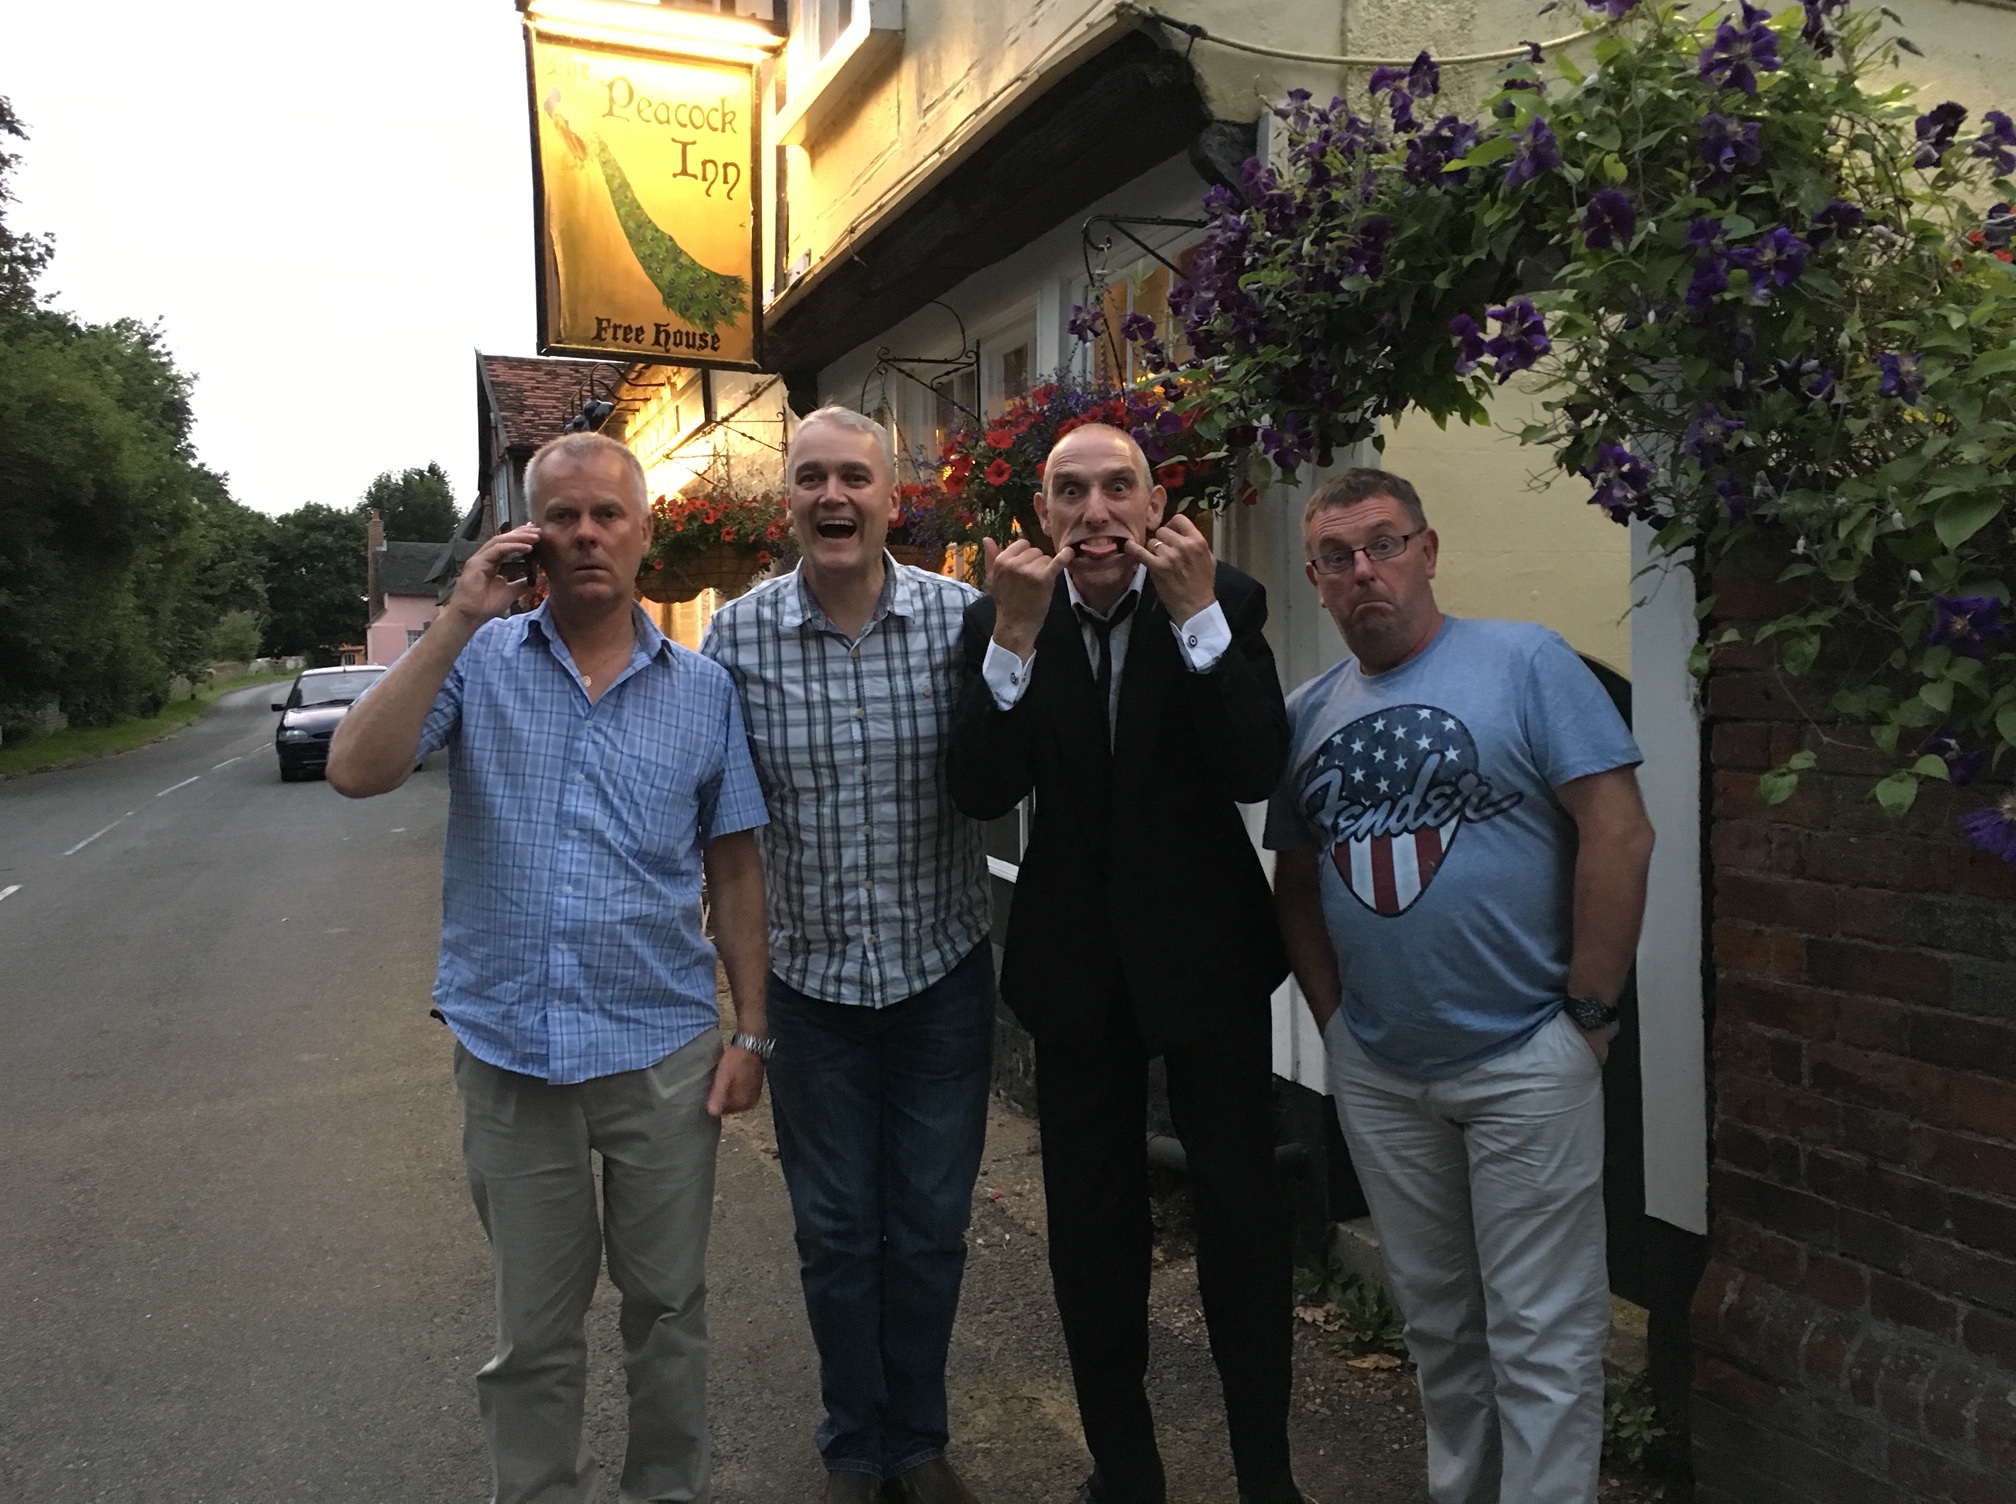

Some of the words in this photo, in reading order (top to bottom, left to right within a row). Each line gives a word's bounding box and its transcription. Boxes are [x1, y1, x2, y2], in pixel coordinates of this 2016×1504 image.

[546, 52, 590, 81] The
[601, 76, 738, 134] Peacock
[671, 137, 741, 201] Inn
[591, 316, 645, 345] Free
[1300, 750, 1525, 843] Fender
